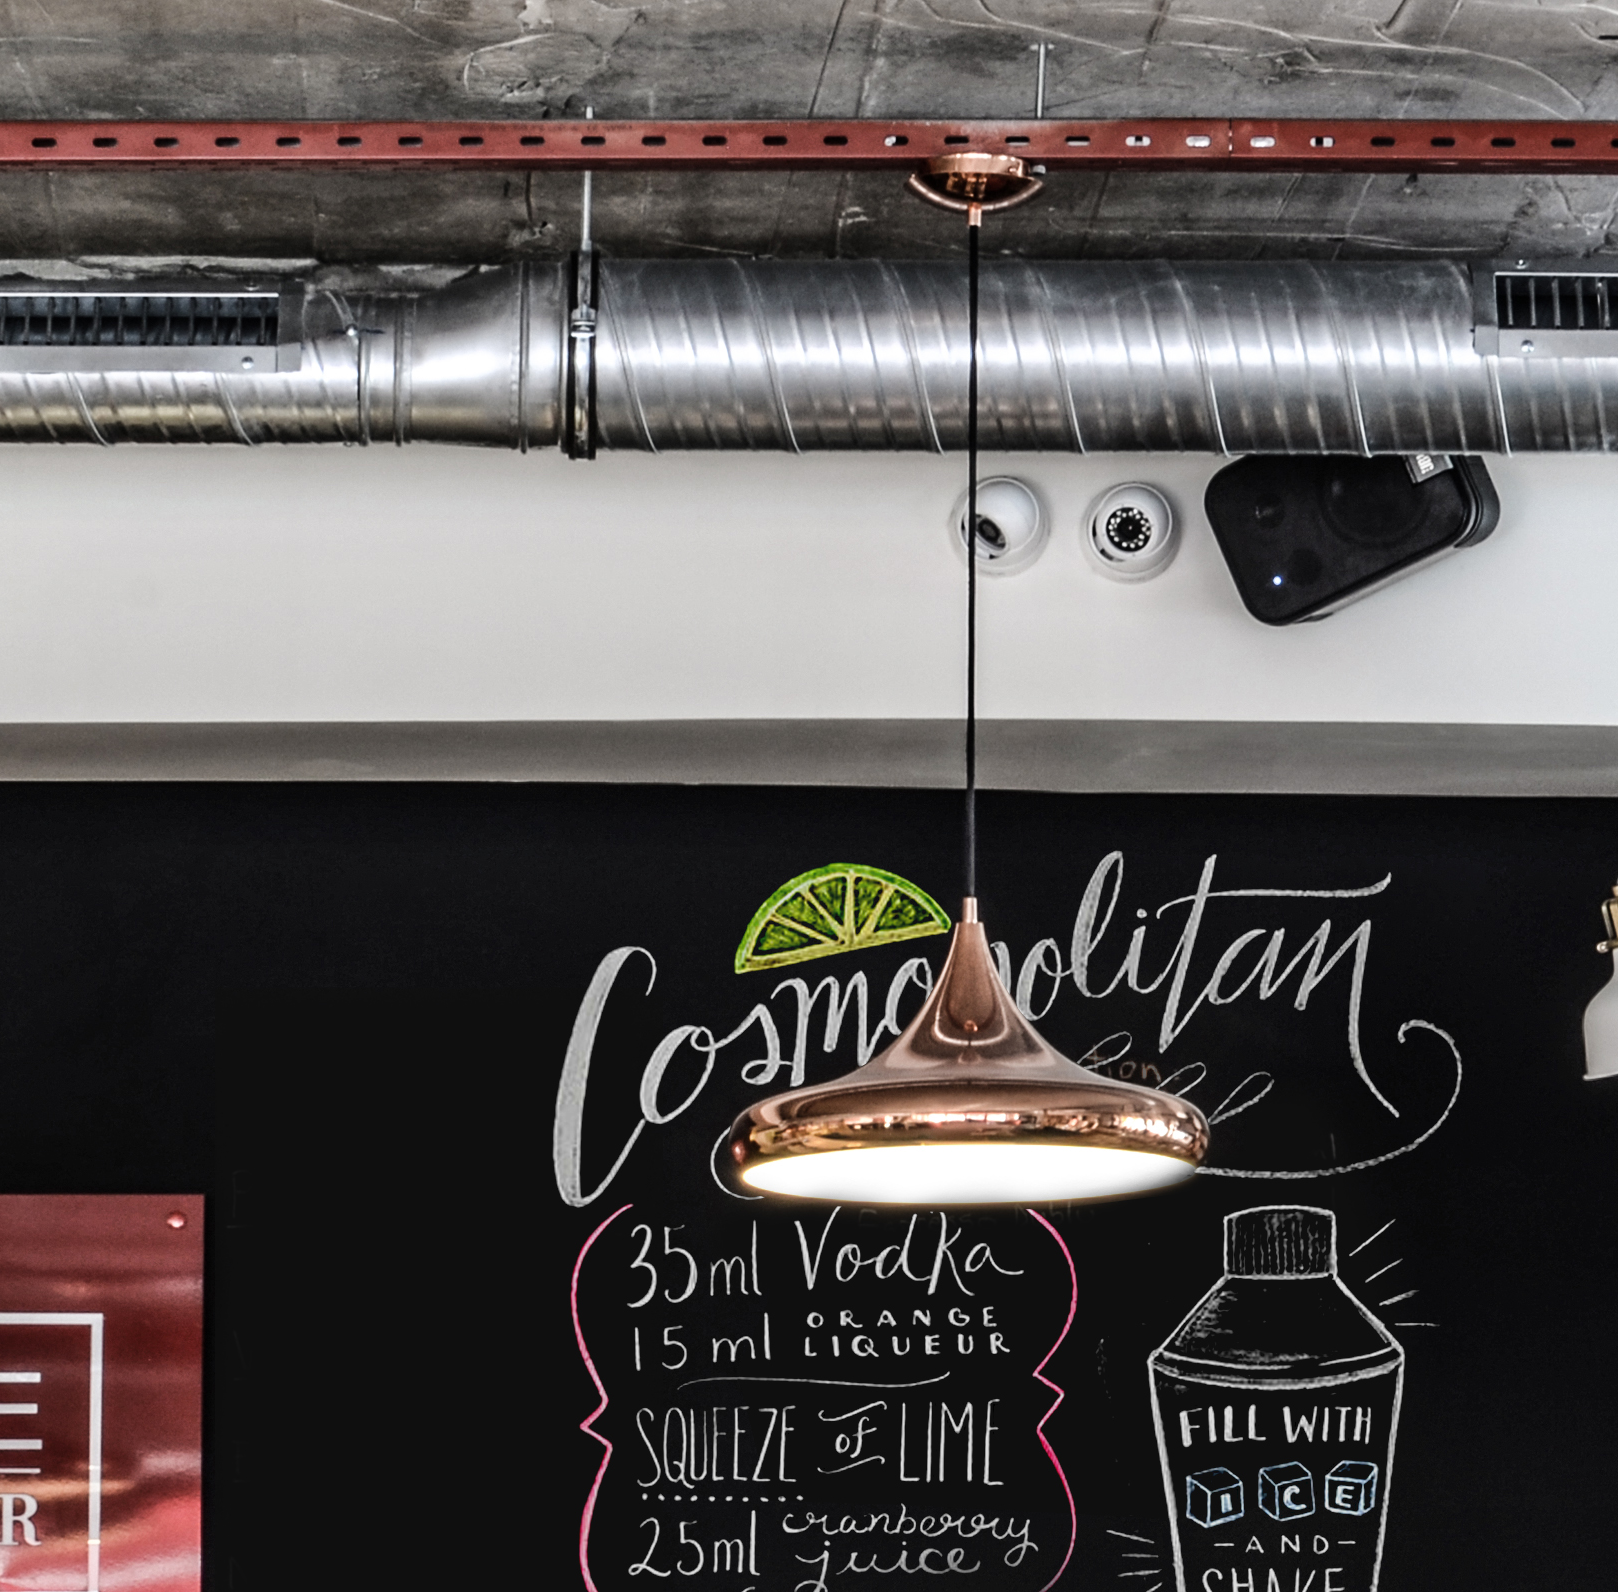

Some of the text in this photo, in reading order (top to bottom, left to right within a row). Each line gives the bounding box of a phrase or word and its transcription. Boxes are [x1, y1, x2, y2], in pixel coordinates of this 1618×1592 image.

[796, 1207, 1025, 1298] Vodka
[806, 1307, 1001, 1331] ORANGE
[803, 1332, 1011, 1360] LIQUEUR
[636, 1404, 798, 1489] SQUEEZE
[899, 1401, 1004, 1487] LIME
[1179, 1402, 1374, 1446] FILL WITH
[782, 1505, 1043, 1568] cranberry
[1245, 1534, 1330, 1555] AND
